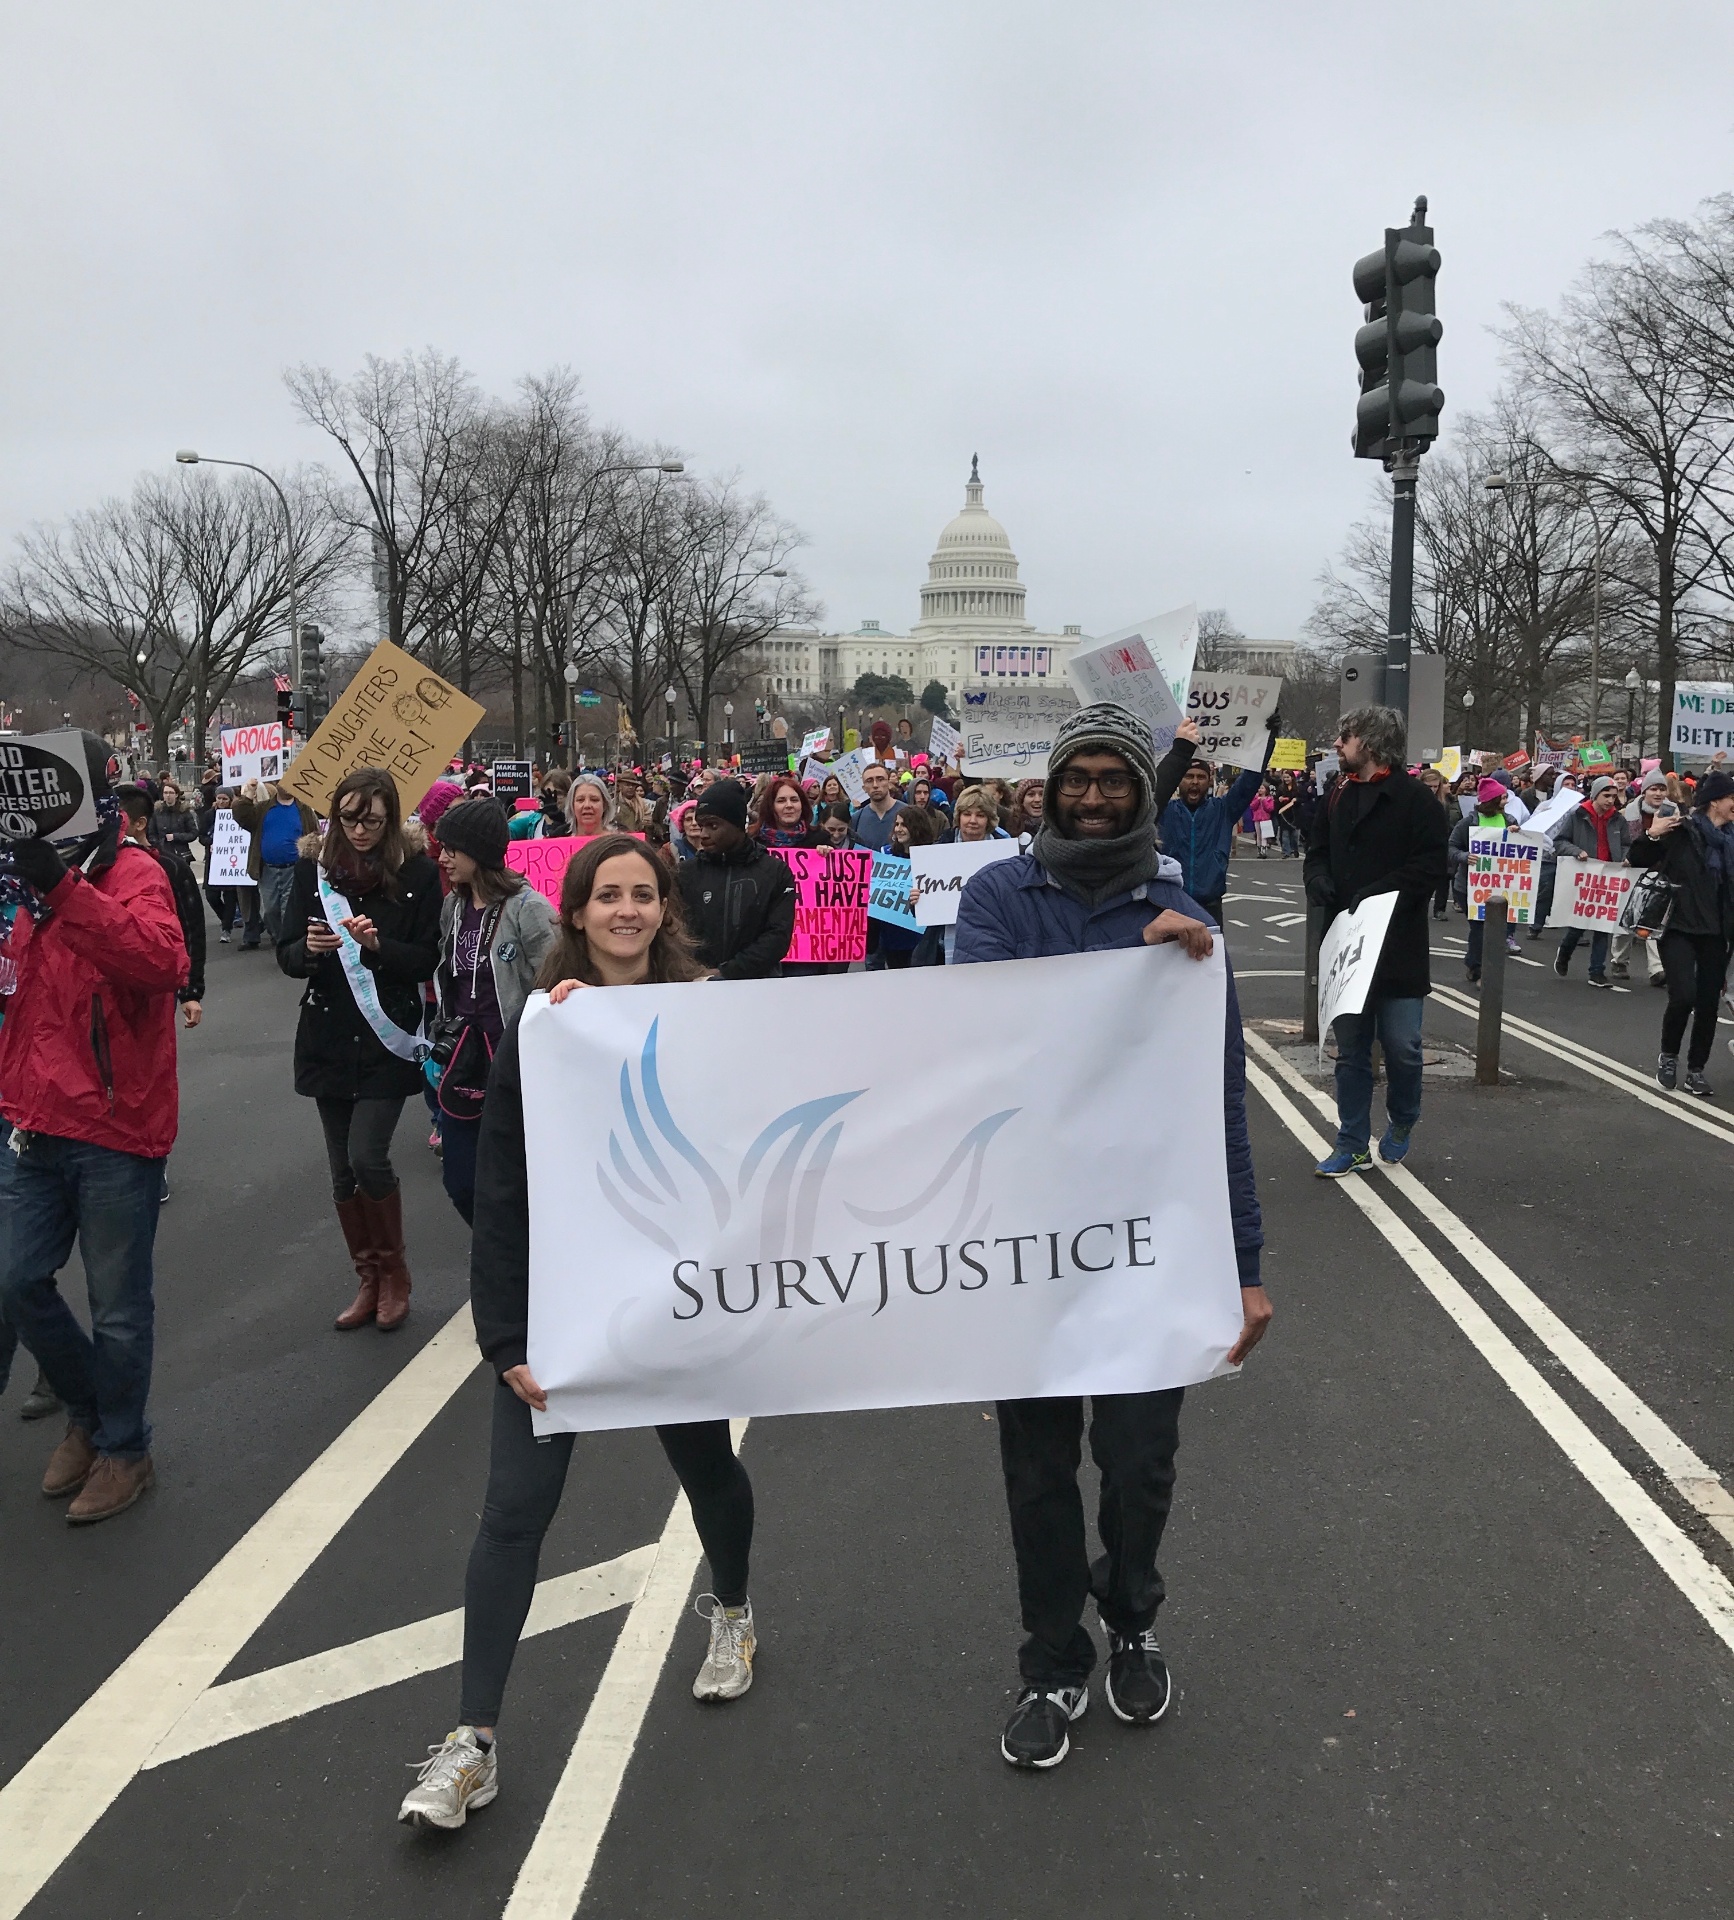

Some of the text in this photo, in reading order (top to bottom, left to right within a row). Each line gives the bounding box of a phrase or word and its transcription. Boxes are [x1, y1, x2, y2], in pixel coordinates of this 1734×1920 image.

[964, 691, 1031, 707] When
[1187, 690, 1230, 710] SUS
[1679, 693, 1734, 714] WE DE
[965, 709, 998, 723] are
[1235, 715, 1249, 727] a
[222, 723, 282, 758] WRONG
[292, 665, 398, 798] MY DAUGHTERS
[1676, 725, 1734, 748] BETTE
[967, 734, 1052, 766] Everyone
[1198, 736, 1242, 753] ugee
[0, 746, 24, 768] ND
[386, 730, 435, 784] TER!
[1539, 752, 1565, 761] FIGHT
[0, 767, 60, 796] TER
[0, 791, 72, 811] RESSION
[228, 835, 243, 844] ARE
[216, 846, 235, 855] WHY
[505, 844, 573, 876] PRO
[1471, 840, 1538, 861] BELIEVE
[820, 850, 870, 882] JUST
[872, 861, 912, 880] IGH
[1476, 857, 1531, 874] IN THE
[915, 873, 965, 894] Ima
[1574, 872, 1631, 892] FILLED
[815, 882, 868, 908] HAVE
[869, 888, 912, 916] IGH
[1579, 887, 1618, 906] WITH
[795, 907, 867, 935] AMENTAL
[1469, 905, 1529, 923] PELE
[1573, 901, 1619, 921] HOPE
[484, 918, 496, 945] DIGITAL
[810, 935, 864, 961] RIGHTS
